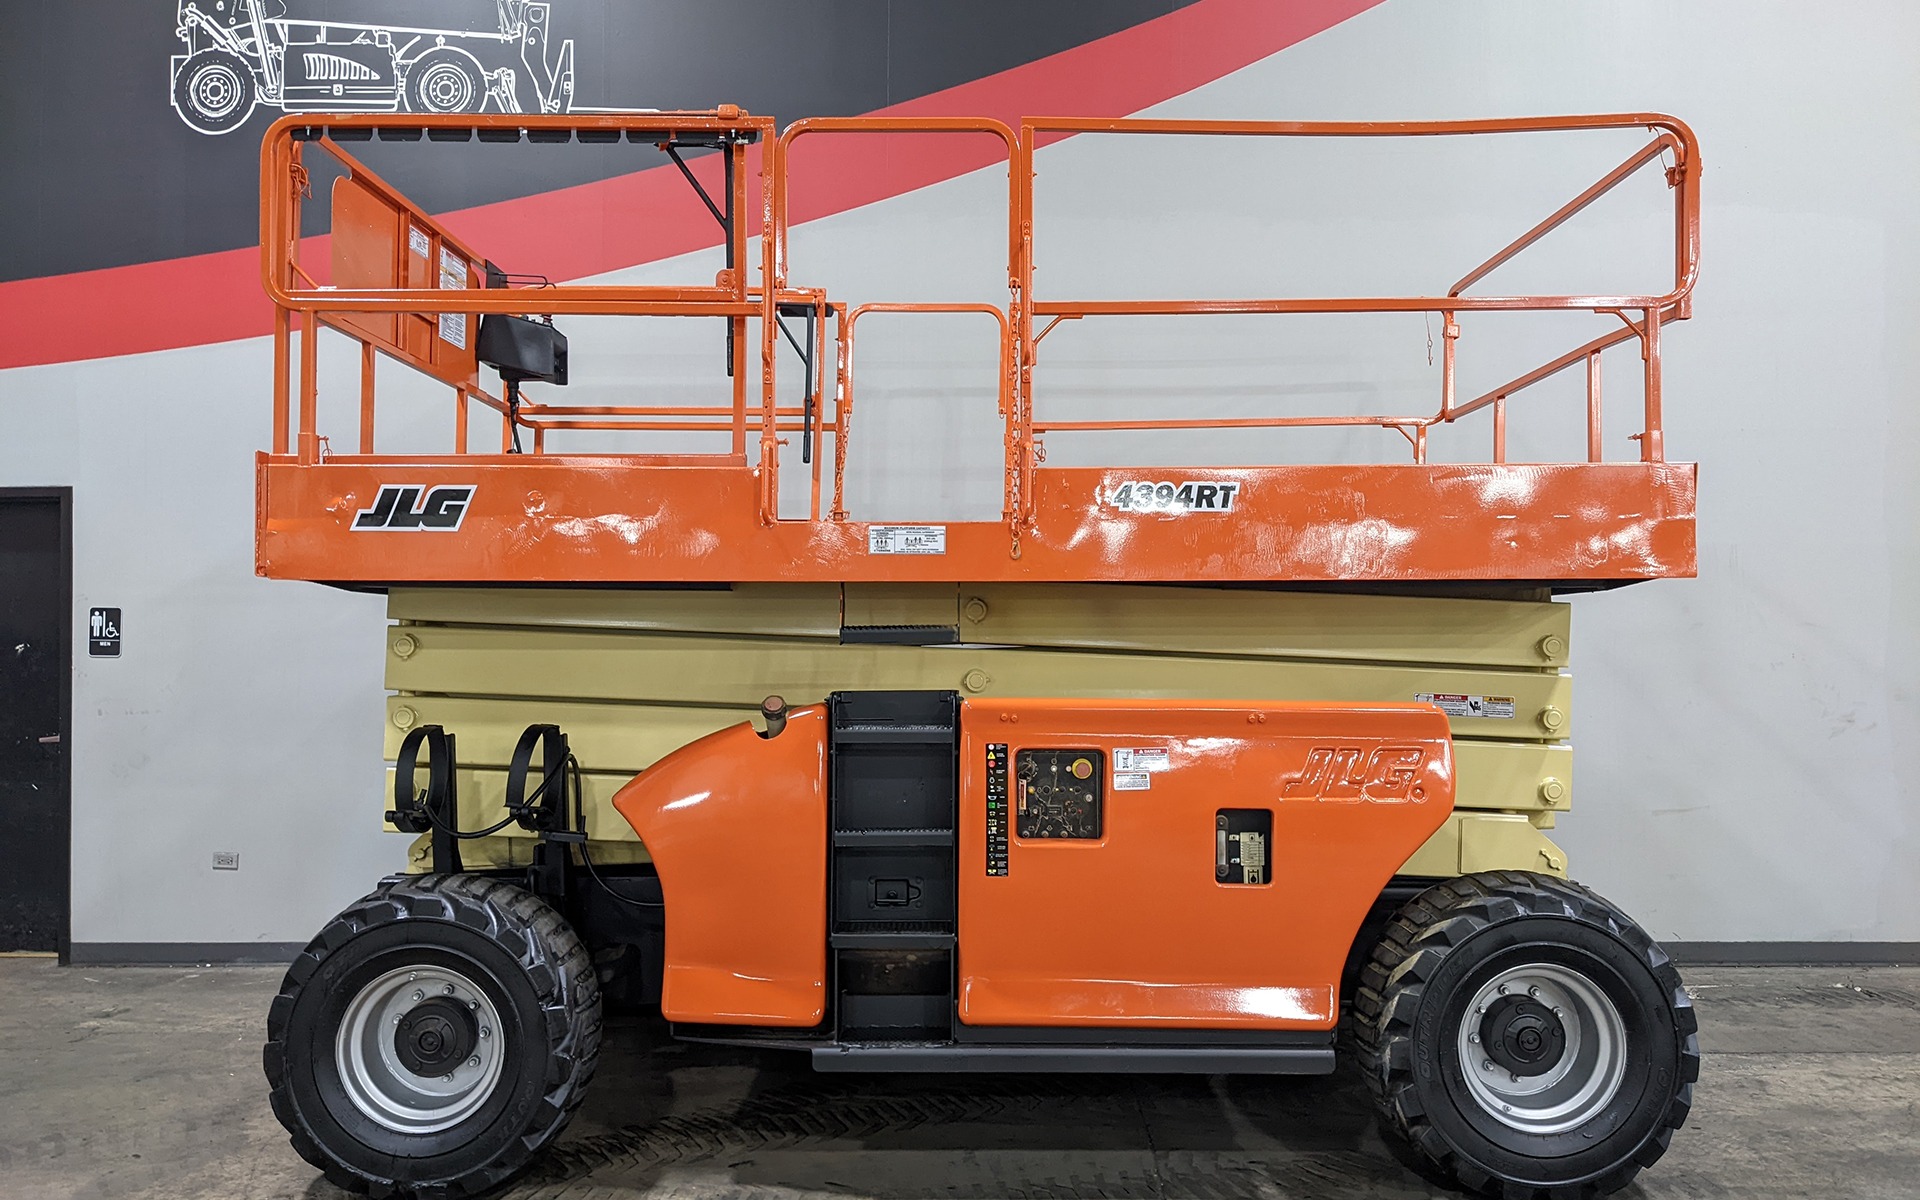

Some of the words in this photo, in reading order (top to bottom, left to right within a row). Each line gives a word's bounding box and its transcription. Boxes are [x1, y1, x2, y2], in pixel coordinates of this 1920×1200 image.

[352, 486, 475, 530] JLG
[1114, 484, 1237, 509] 4394RT
[1279, 746, 1425, 803] JLG
